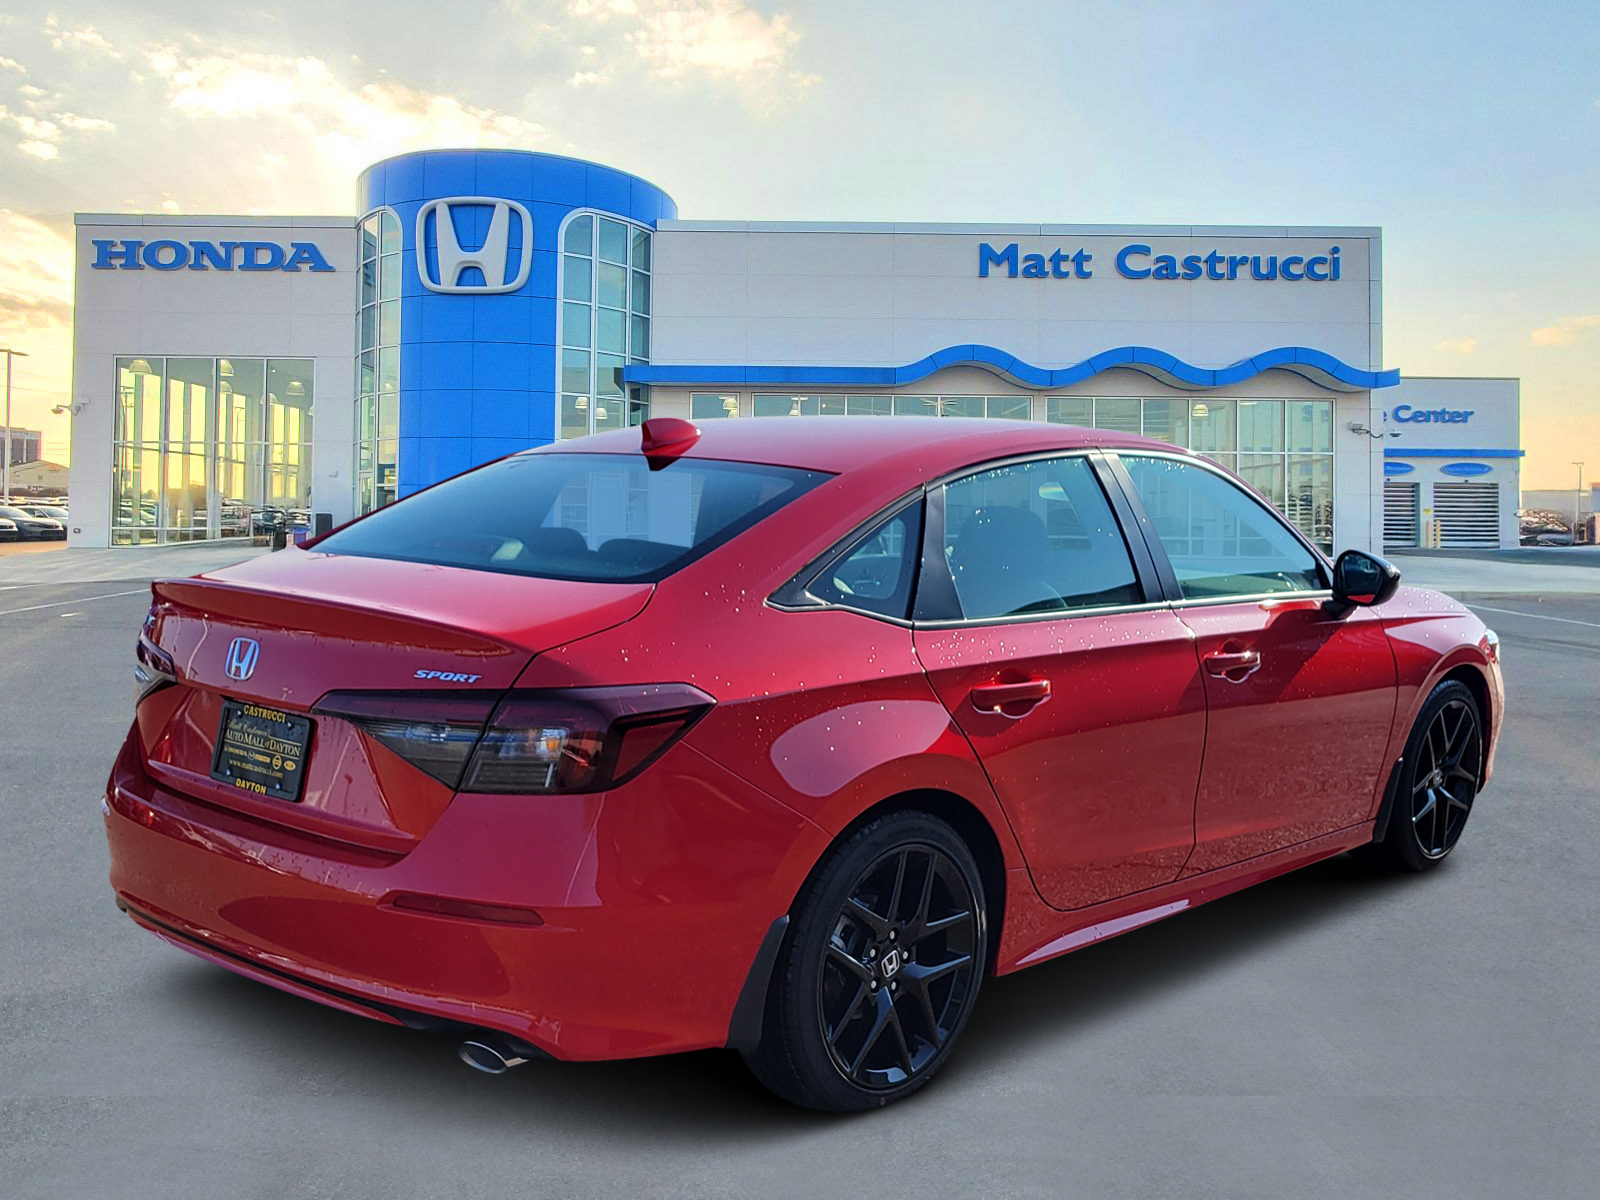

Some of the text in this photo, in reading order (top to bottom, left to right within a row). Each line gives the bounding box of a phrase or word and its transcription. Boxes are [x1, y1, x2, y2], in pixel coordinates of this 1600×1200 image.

[91, 239, 336, 272] HONDA
[978, 242, 1342, 281] Matt Castrucci
[1392, 404, 1475, 423] Center
[413, 669, 483, 683] SPORT
[243, 705, 286, 723] CASTRUCCI
[269, 739, 301, 756] DAYTON
[235, 778, 267, 795] DAYTON
